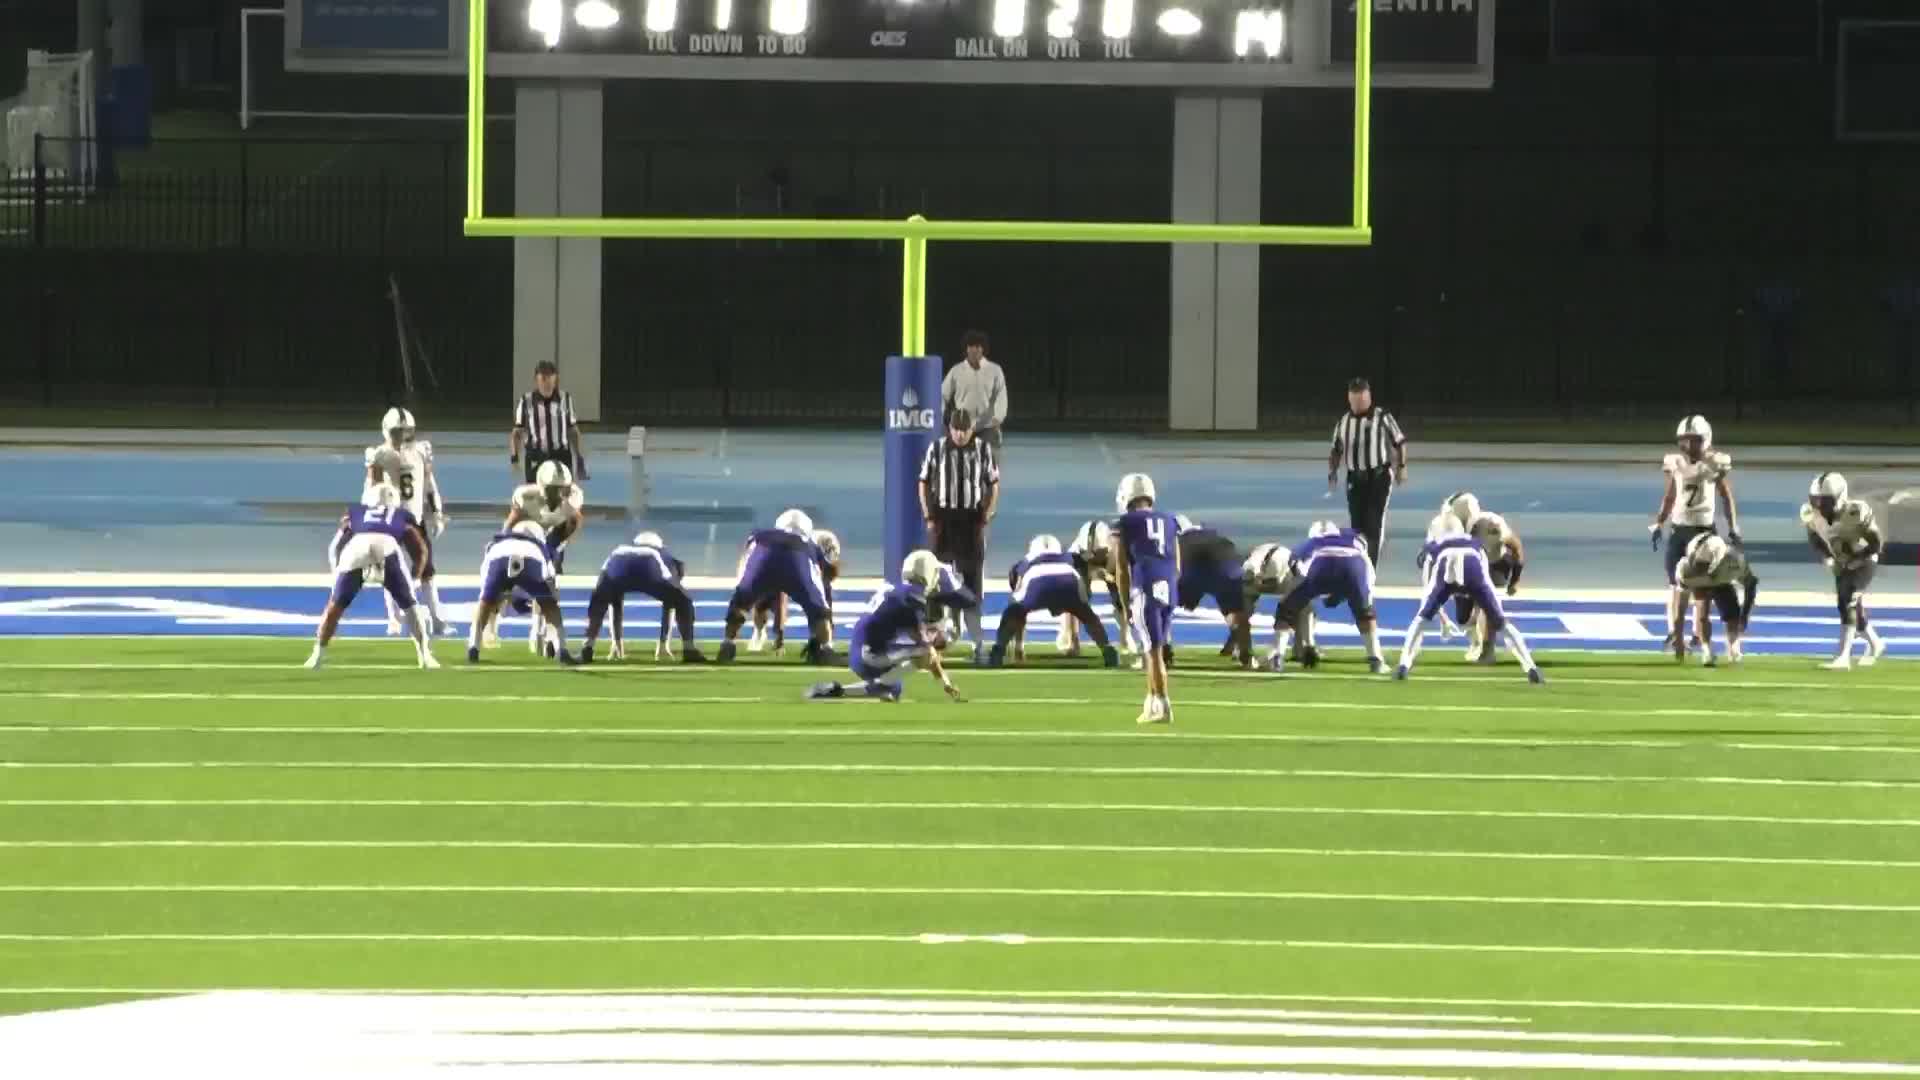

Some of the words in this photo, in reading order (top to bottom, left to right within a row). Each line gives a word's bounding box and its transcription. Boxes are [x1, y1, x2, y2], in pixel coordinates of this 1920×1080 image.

[689, 34, 743, 54] DOWN
[757, 34, 778, 54] TO
[955, 37, 997, 58] BALL
[1003, 38, 1028, 58] ON
[1048, 38, 1080, 60] QTR
[889, 409, 934, 429] IMG
[1145, 517, 1165, 555] 4
